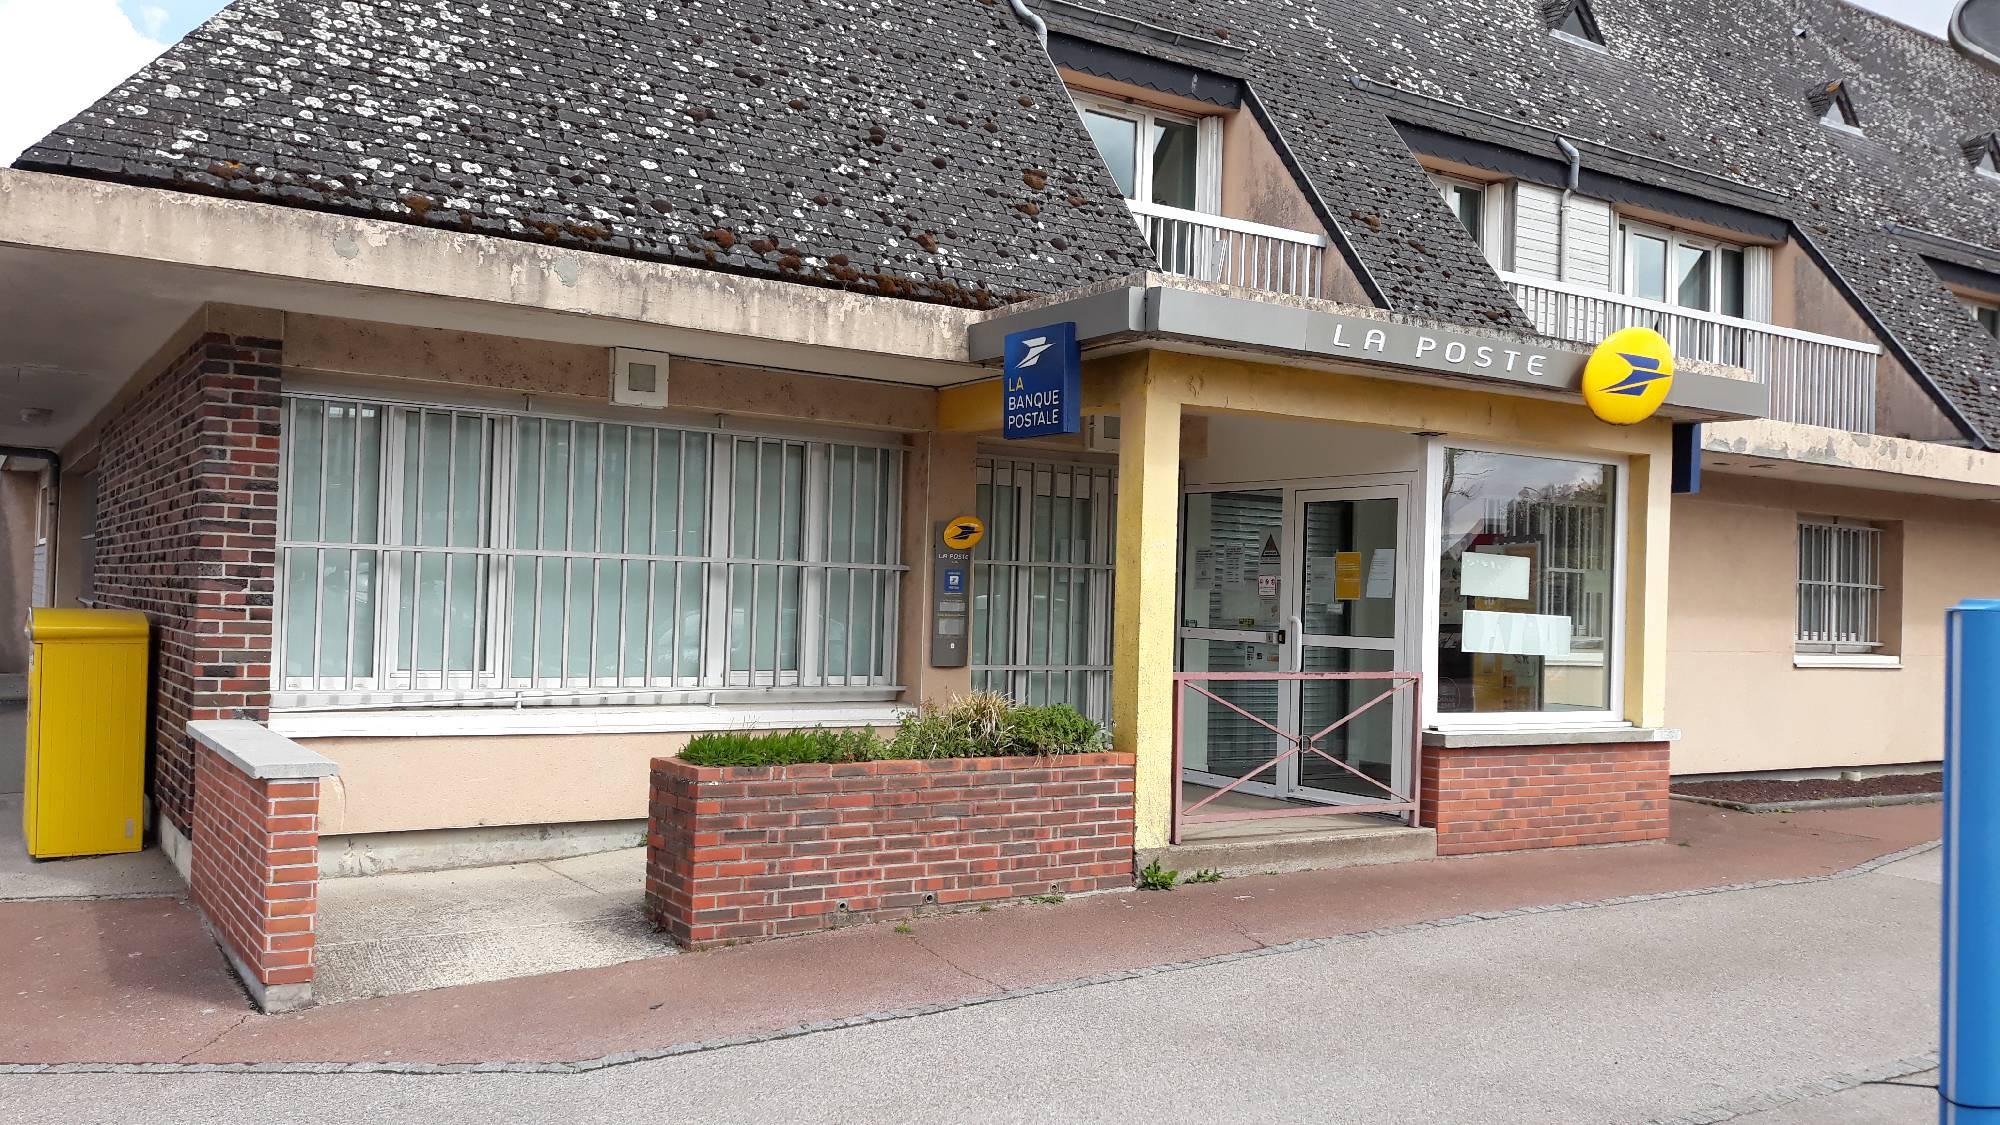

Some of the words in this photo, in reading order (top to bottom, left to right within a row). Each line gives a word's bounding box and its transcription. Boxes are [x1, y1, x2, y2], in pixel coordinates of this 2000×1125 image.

[1332, 323, 1387, 353] LA
[1414, 335, 1548, 377] POSTE
[1008, 376, 1024, 392] LA
[1008, 389, 1061, 411] BANQUE
[1008, 408, 1060, 430] POSTALE
